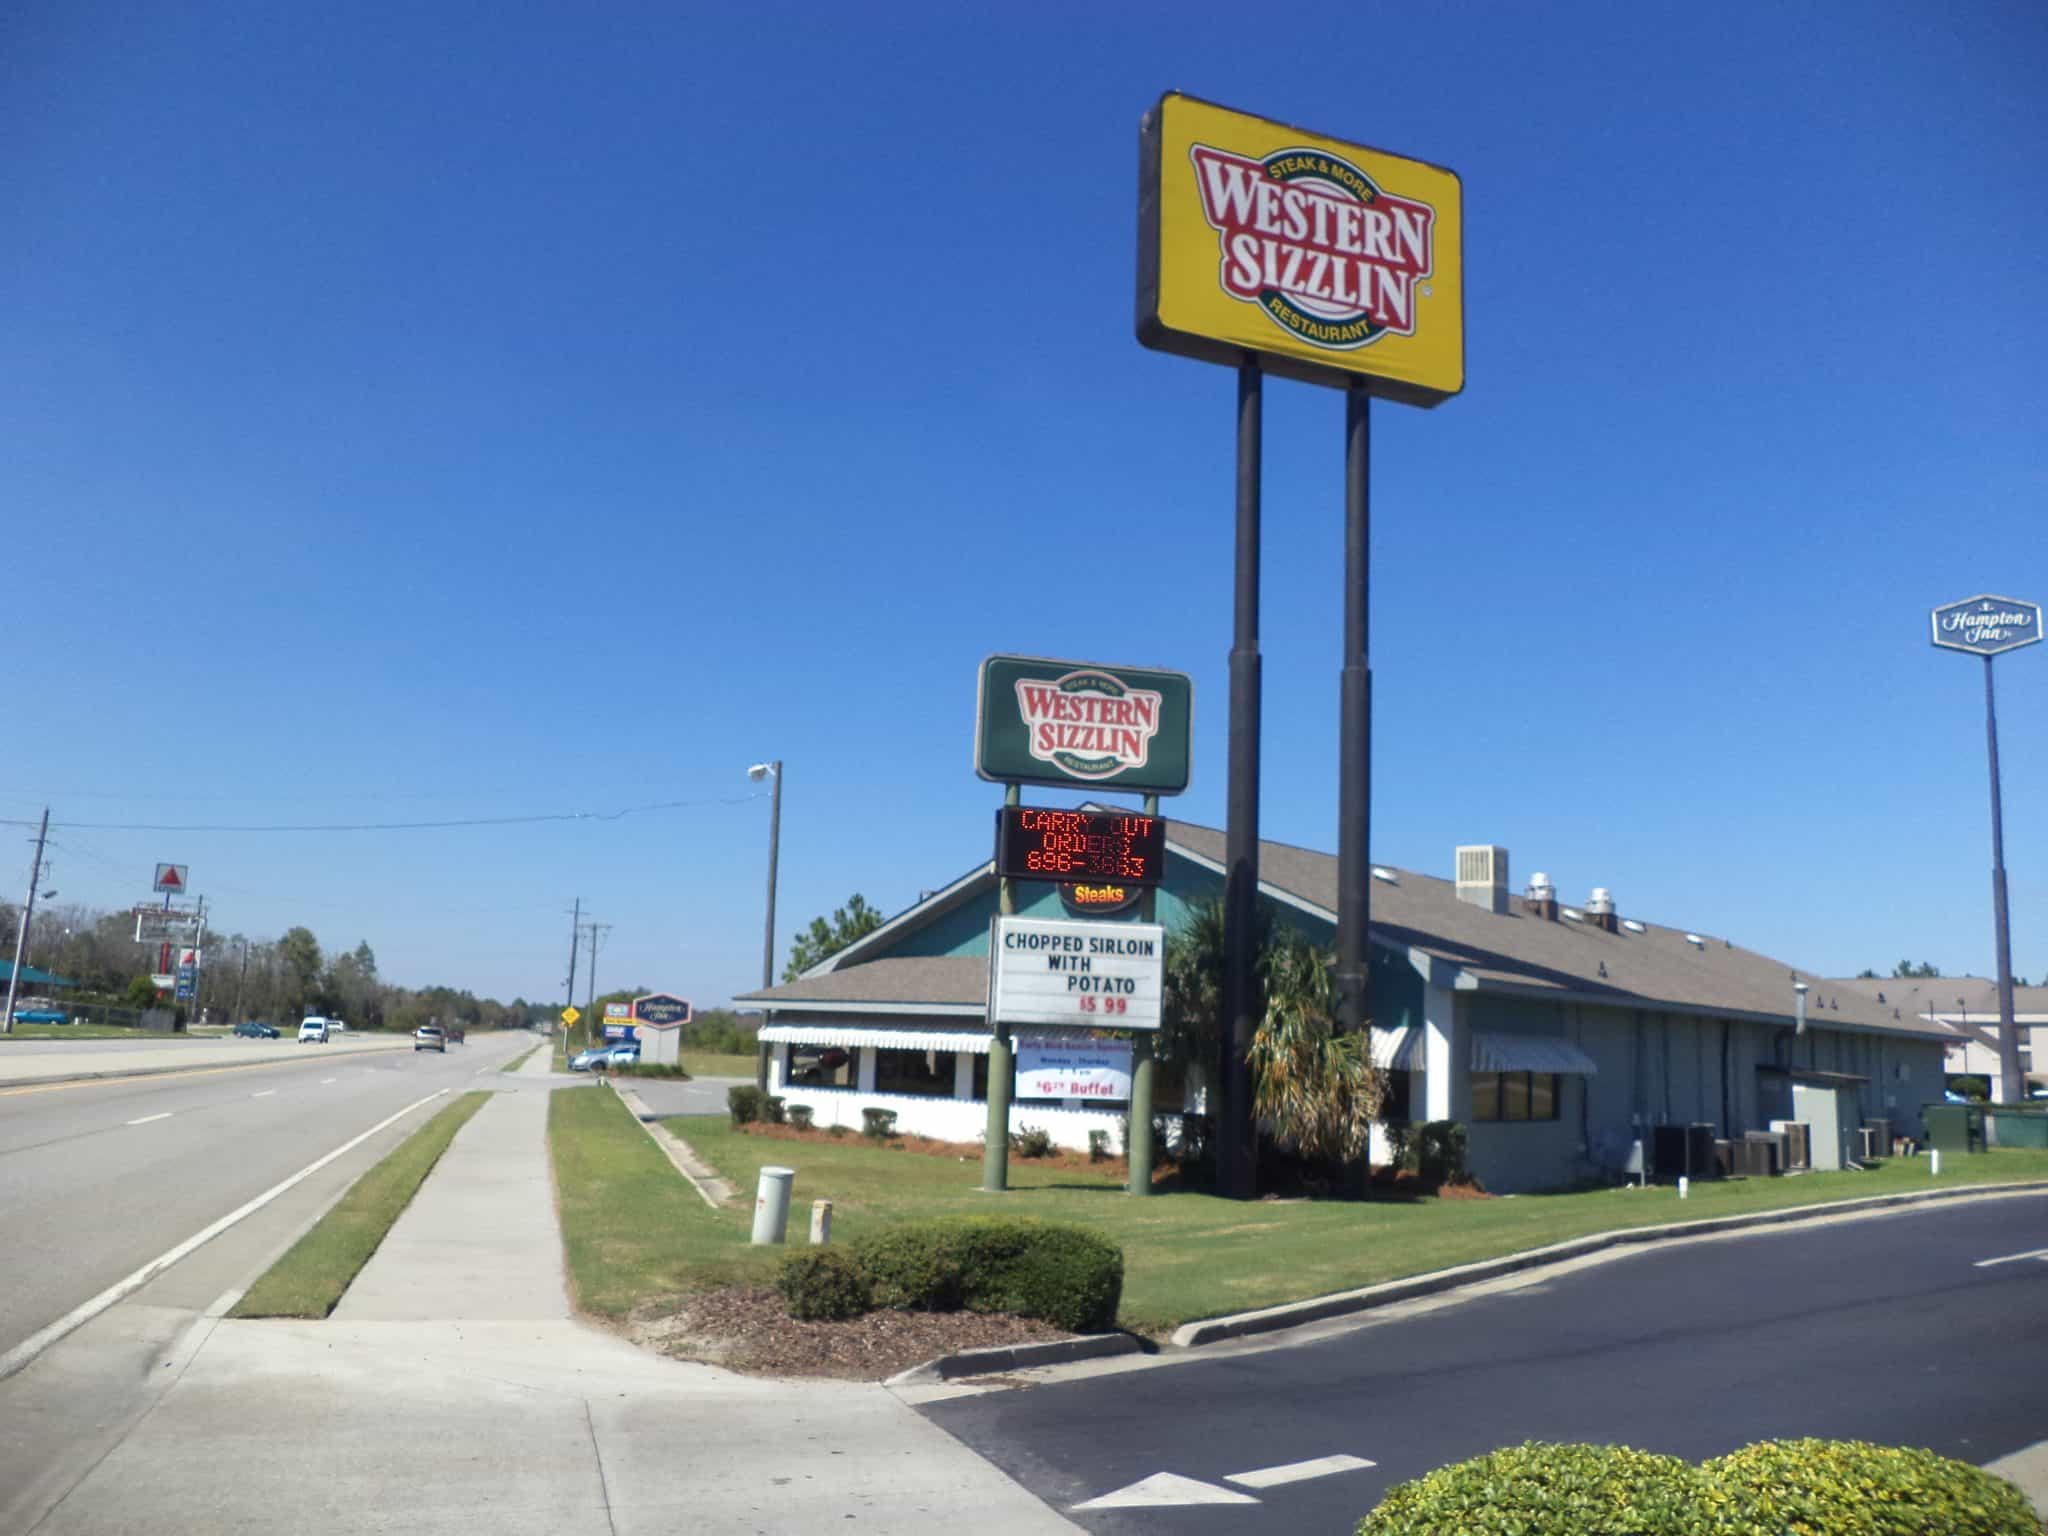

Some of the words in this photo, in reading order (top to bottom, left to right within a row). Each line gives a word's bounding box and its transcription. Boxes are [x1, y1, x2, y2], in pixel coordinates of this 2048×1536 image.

[1269, 157, 1315, 179] STEAK
[1318, 160, 1329, 174] &
[1331, 164, 1372, 201] MORE
[1202, 157, 1426, 269] WESTERN
[1231, 233, 1410, 326] SIZZLIN
[1268, 297, 1370, 341] RESTAURANT
[1942, 611, 2031, 631] Hampton
[1965, 625, 2010, 643] Inn
[1023, 686, 1154, 729] WESTERN
[1039, 722, 1143, 758] SIZZLIN
[1074, 884, 1124, 904] Steaks
[1005, 933, 1083, 952] CHOPPED
[1089, 938, 1154, 956] SIRLOIN
[1048, 955, 1091, 972] WITH
[1068, 975, 1136, 994] POTATO
[1070, 1082, 1115, 1095] Buffet
